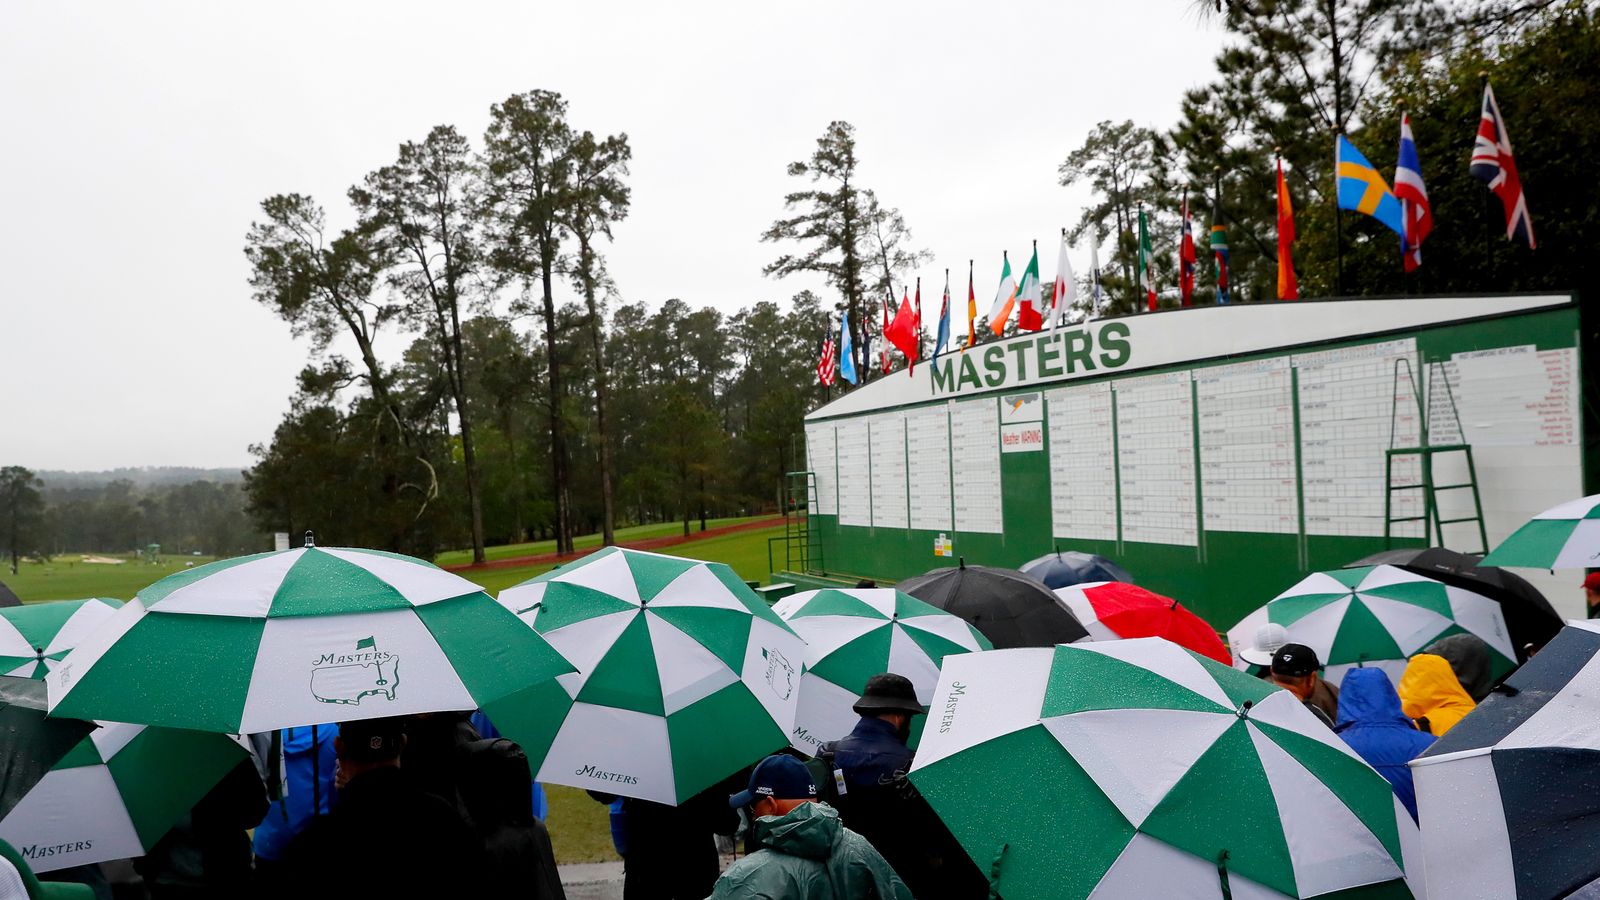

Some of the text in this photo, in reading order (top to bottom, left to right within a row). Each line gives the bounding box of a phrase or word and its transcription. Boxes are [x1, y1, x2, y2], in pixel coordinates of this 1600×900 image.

[930, 322, 1131, 395] MASTERS
[1021, 428, 1042, 444] WARNING
[312, 651, 390, 666] MASTERS
[940, 680, 967, 734] MASTERS
[793, 726, 823, 747] MAST
[575, 764, 639, 785] MASTERS
[21, 839, 93, 859] MASTERS
